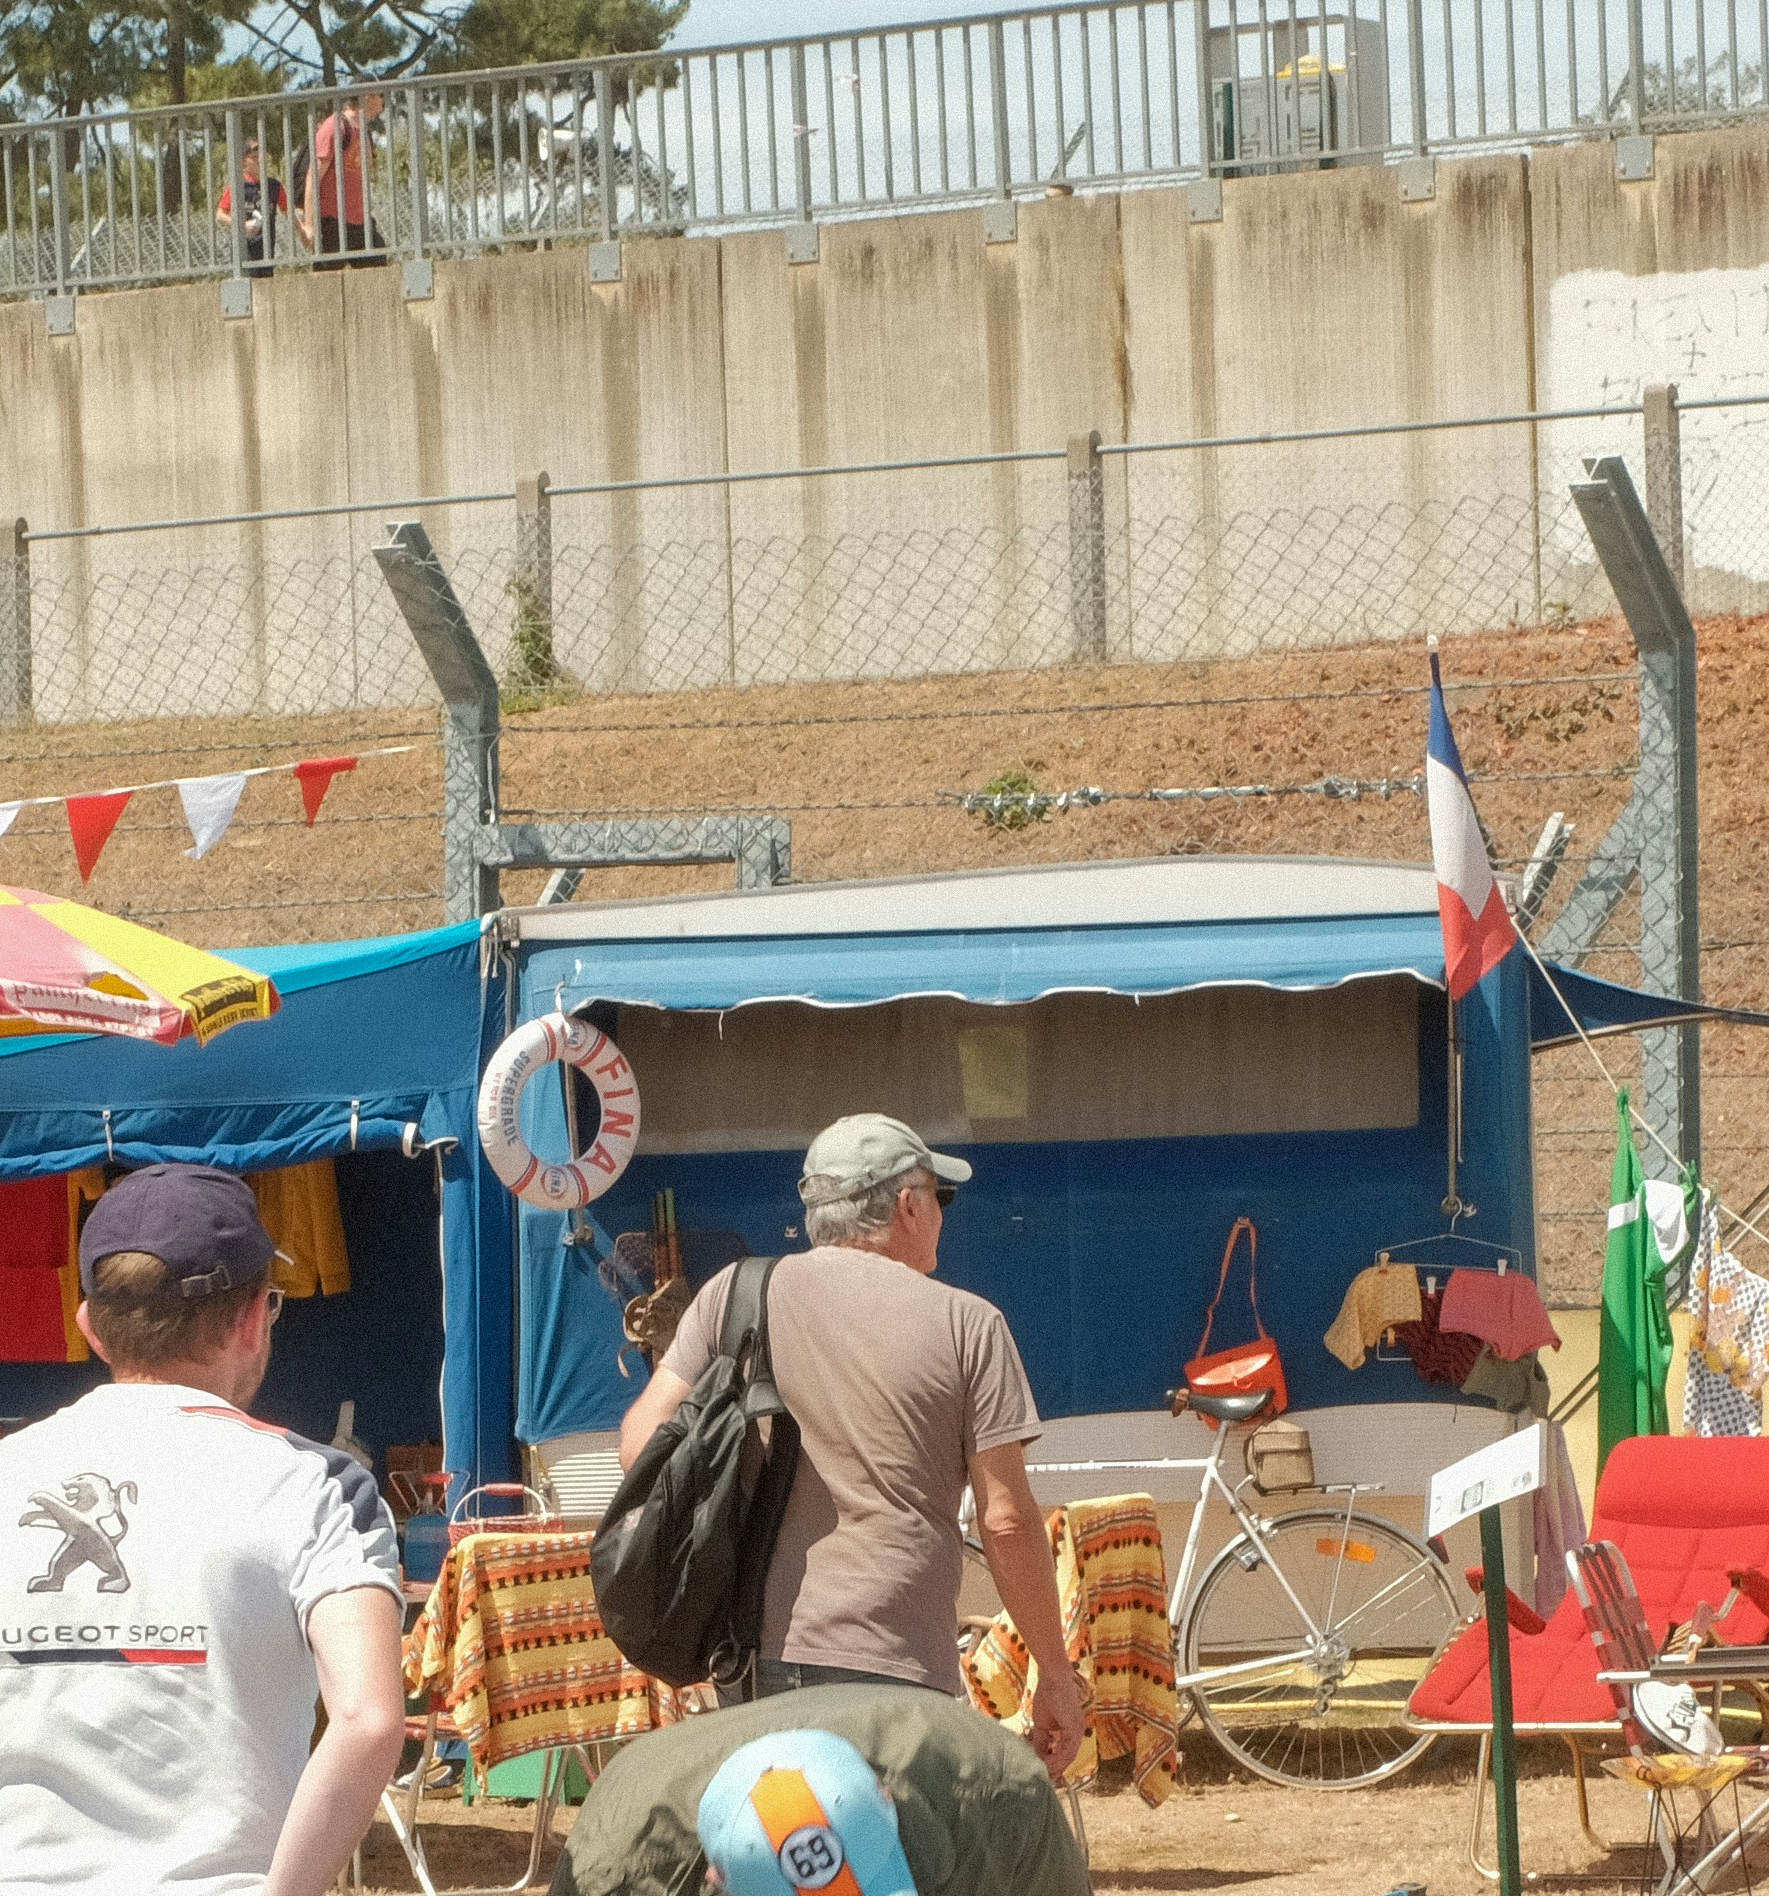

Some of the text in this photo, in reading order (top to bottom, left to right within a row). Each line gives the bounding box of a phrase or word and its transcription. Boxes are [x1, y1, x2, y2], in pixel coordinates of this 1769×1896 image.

[500, 1050, 531, 1148] SUPERGRADE
[583, 1054, 635, 1176] FINA
[129, 1624, 209, 1644] SPORT
